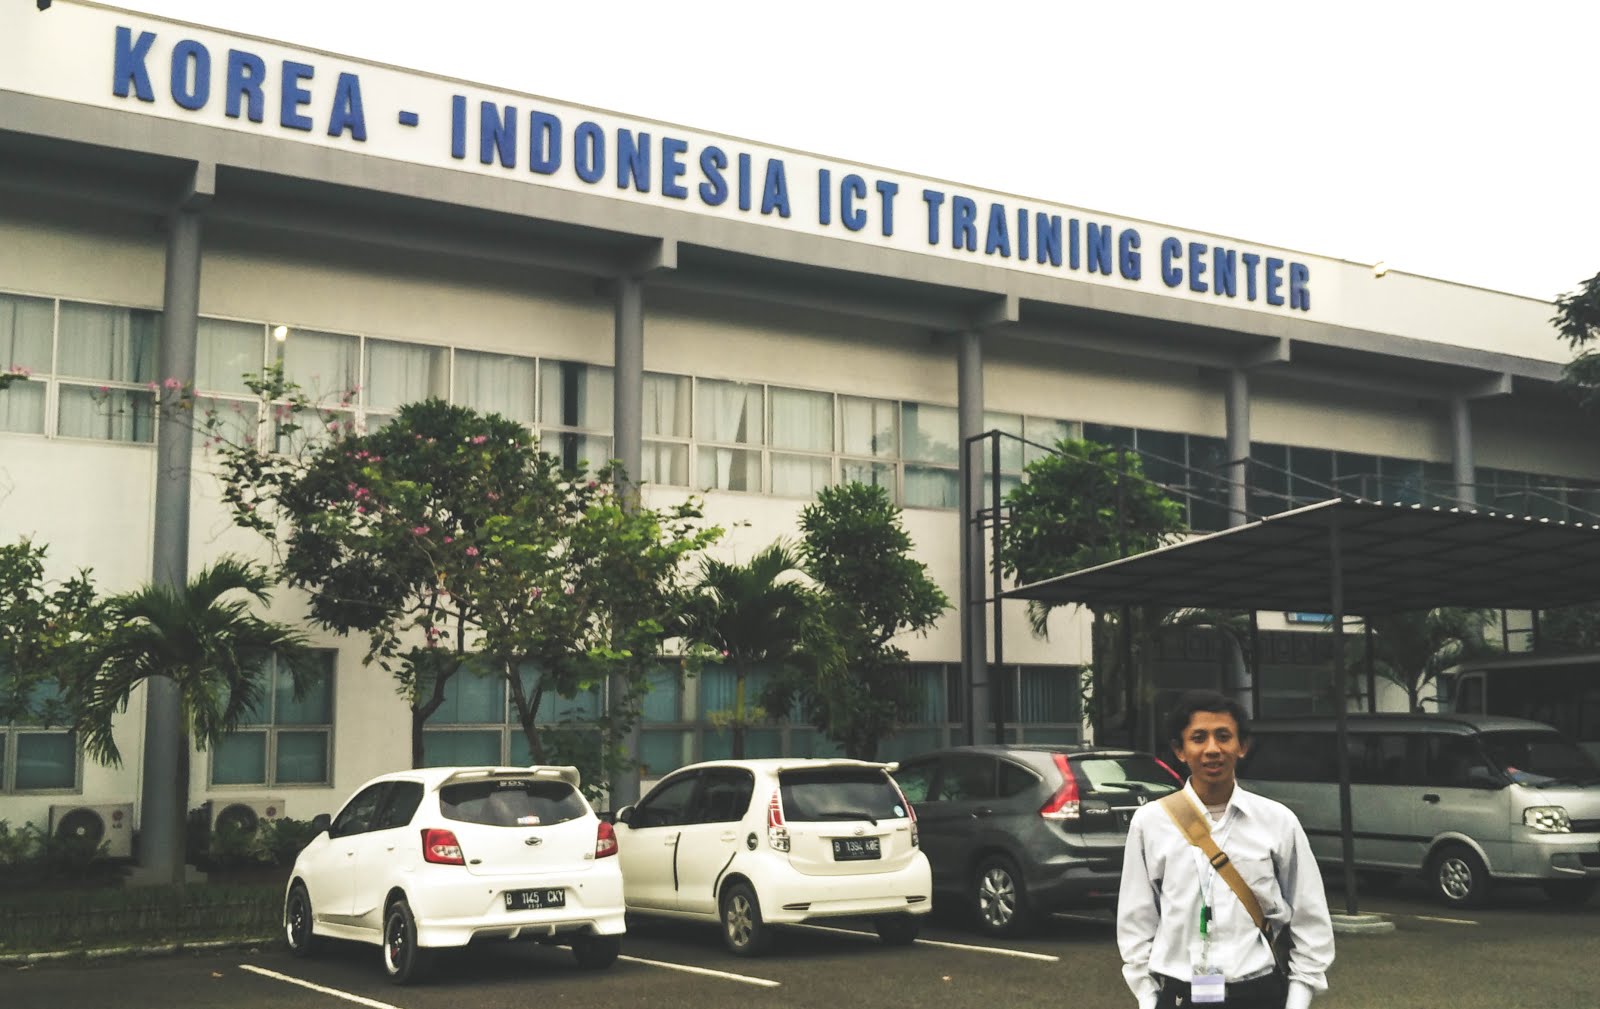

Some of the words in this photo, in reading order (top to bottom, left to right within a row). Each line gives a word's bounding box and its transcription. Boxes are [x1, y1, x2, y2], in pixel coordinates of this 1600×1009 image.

[113, 26, 367, 141] KOREA
[398, 110, 419, 127] -
[451, 95, 791, 218] INDONESIA
[818, 168, 898, 236] ICT
[923, 189, 1142, 281] TRAINING
[1161, 236, 1310, 311] CENTER
[506, 893, 513, 905] B
[522, 891, 540, 903] 1145
